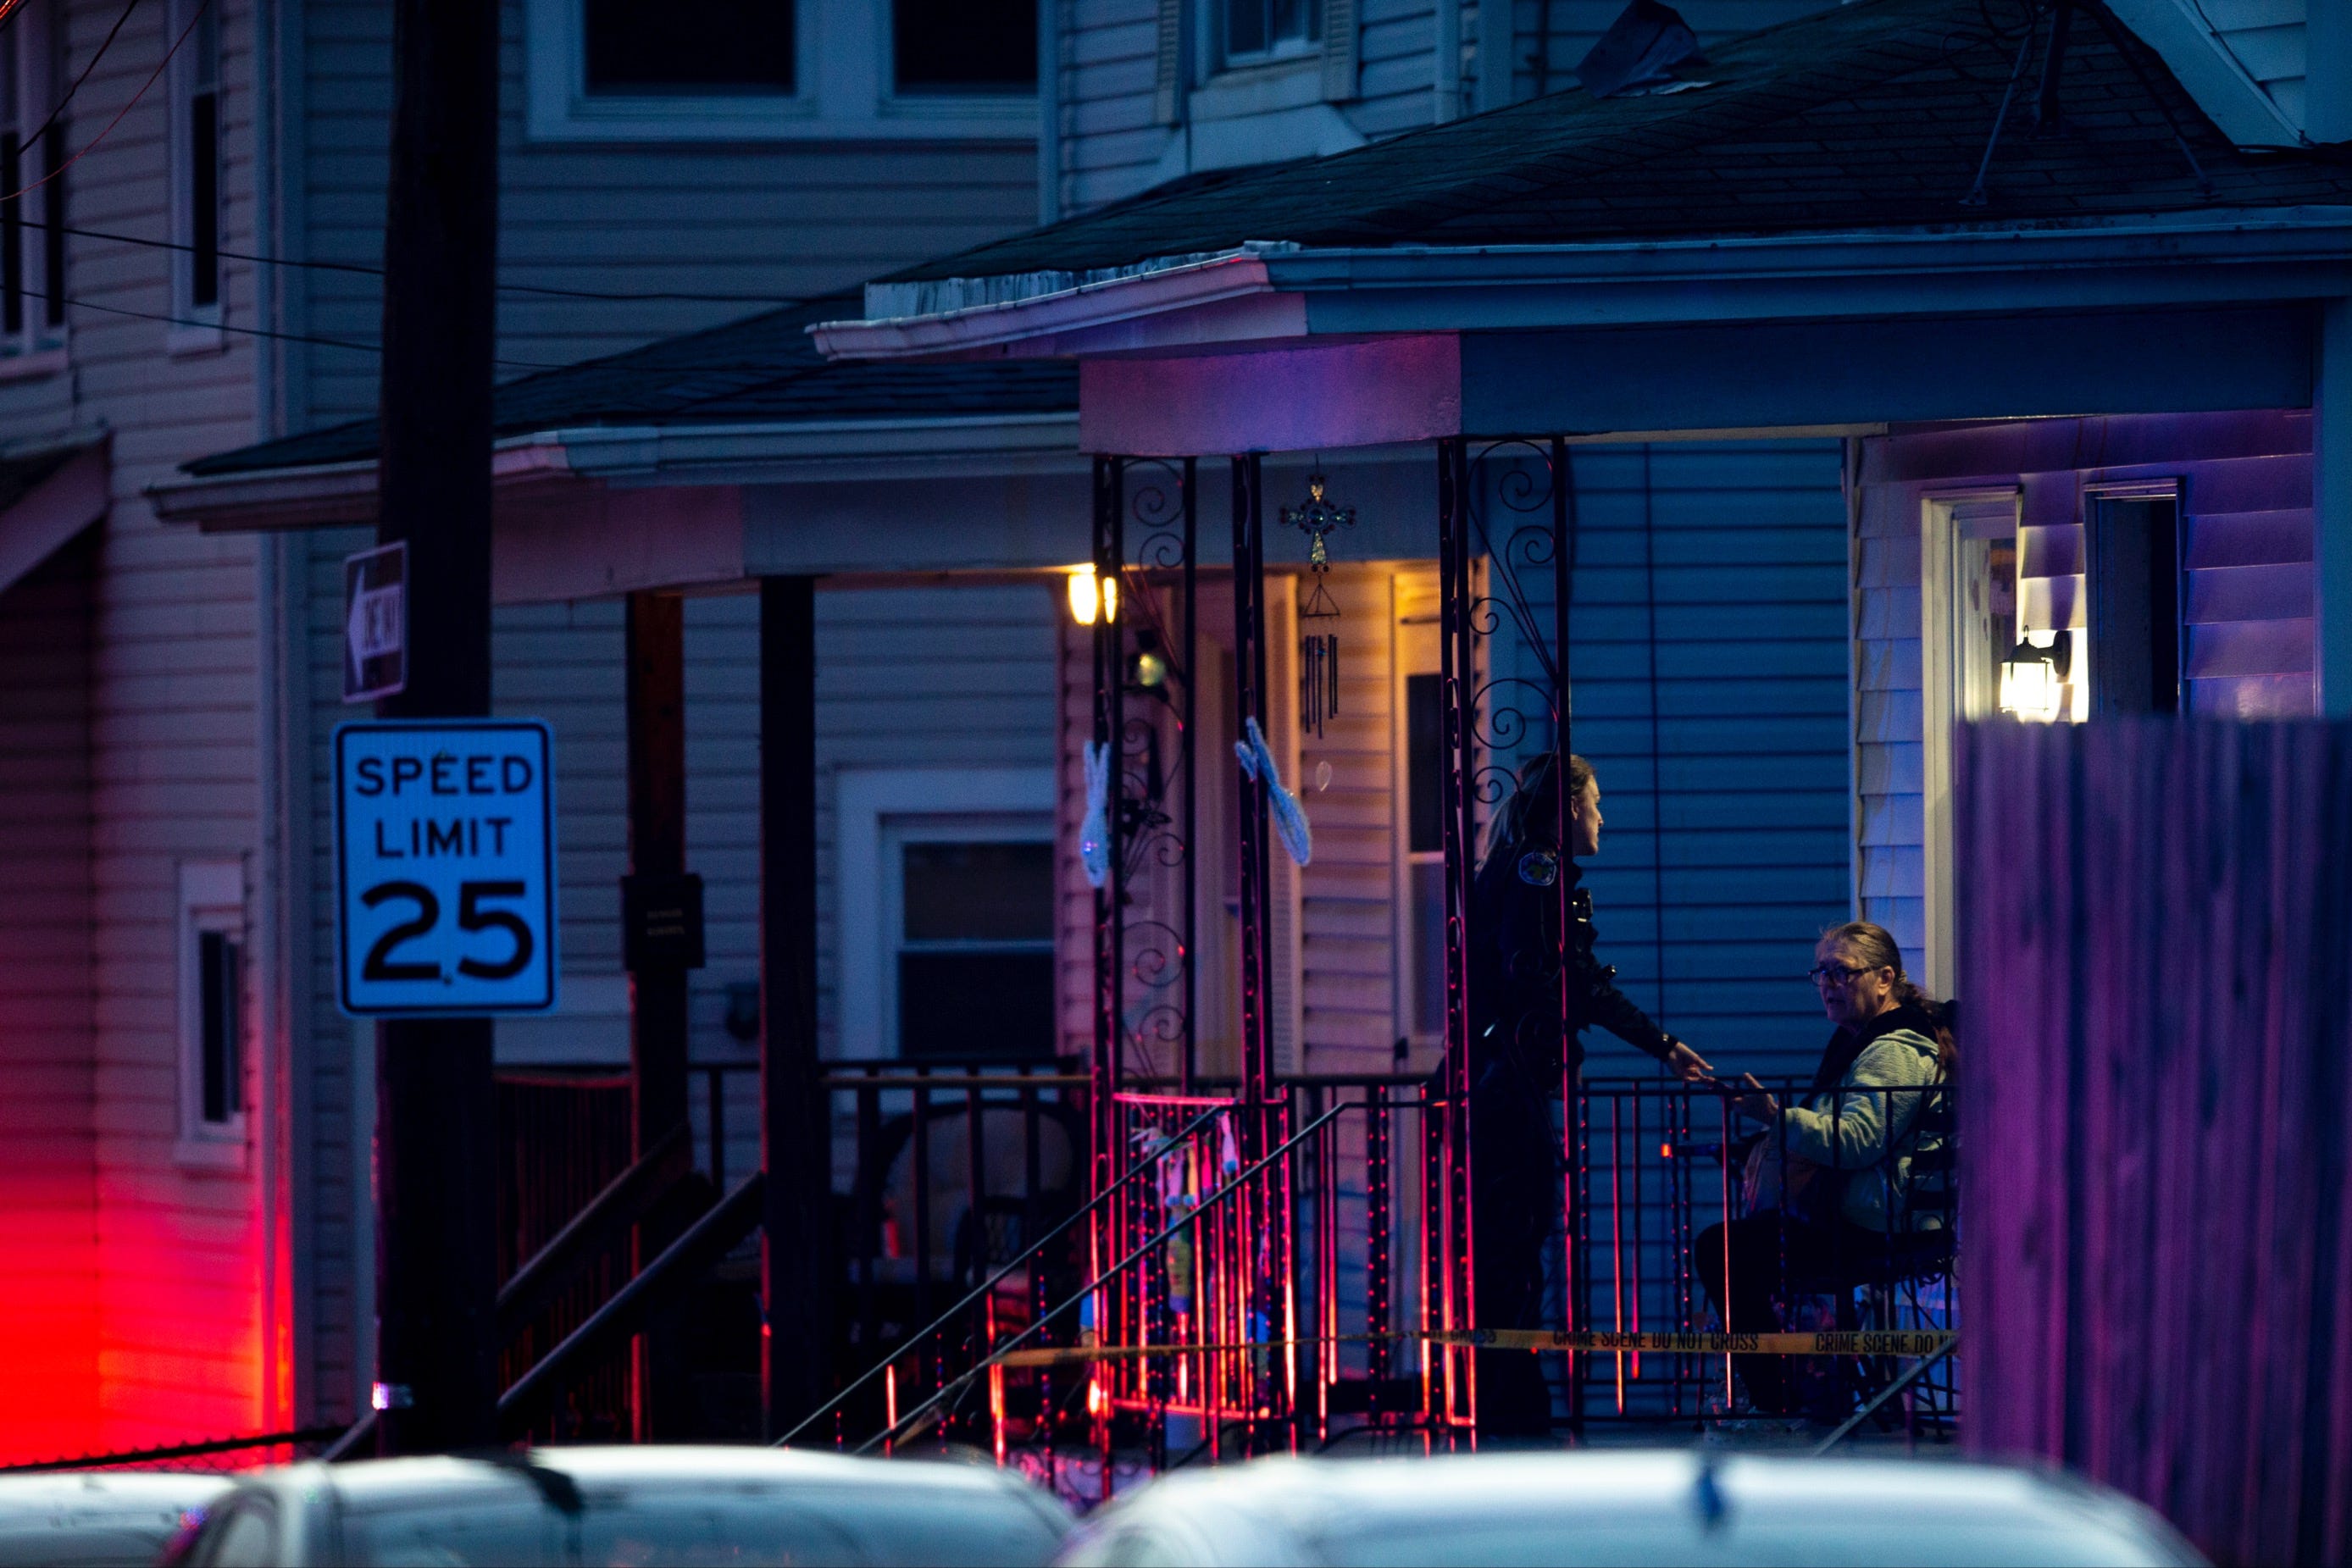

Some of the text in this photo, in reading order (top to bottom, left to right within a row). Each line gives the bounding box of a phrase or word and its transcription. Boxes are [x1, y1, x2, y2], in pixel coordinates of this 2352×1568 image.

[355, 756, 533, 795] SPEED
[375, 817, 513, 858] LIMIT
[360, 880, 534, 982] 25
[1601, 1332, 1645, 1348] SCENE
[1678, 1333, 1702, 1349] NOT
[1711, 1333, 1759, 1350] CROSS
[1816, 1333, 1859, 1352] CRIME
[1863, 1333, 1908, 1353] SCENE
[1915, 1334, 1933, 1354] DO
